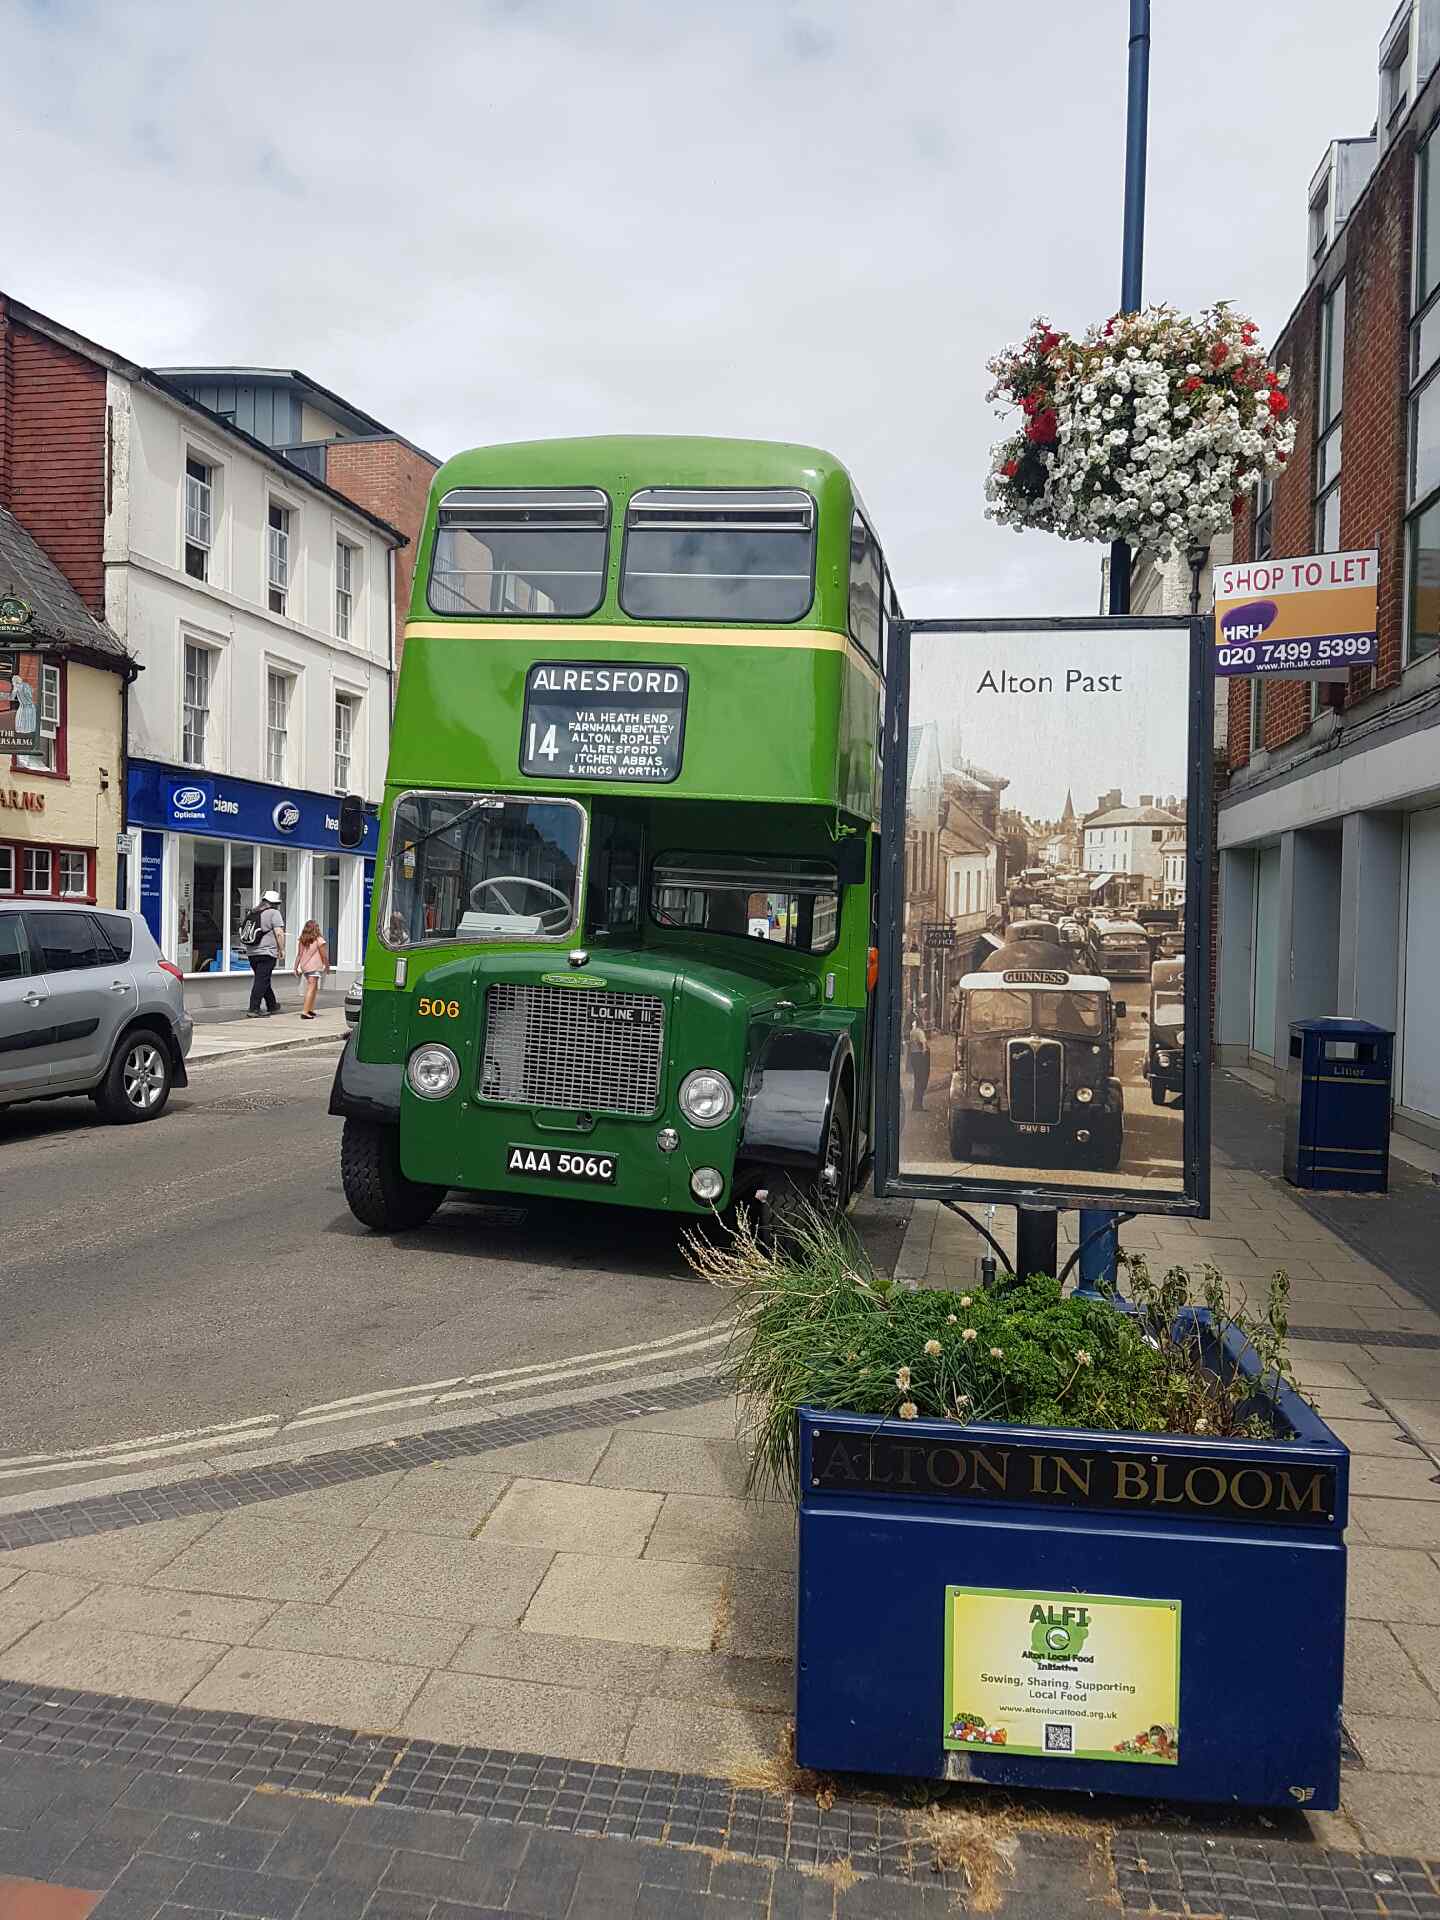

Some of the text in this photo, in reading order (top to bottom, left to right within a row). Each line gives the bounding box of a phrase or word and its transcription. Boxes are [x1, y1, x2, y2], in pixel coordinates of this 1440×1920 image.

[1223, 557, 1371, 594] SHOP TO LET
[1223, 623, 1263, 642] HRH
[1218, 636, 1371, 666] 020 7499 5399
[1256, 657, 1331, 672] www.hrh.uk.com
[533, 669, 679, 693] ALRESFORD
[976, 669, 1122, 694] Alton Past
[576, 711, 668, 724] VIA HEATH END
[528, 723, 559, 762] 14
[571, 733, 670, 746] ALTON. ROPLEY
[580, 744, 658, 755] ALRESFORD
[575, 753, 663, 766] ITCHEN ABBAS
[568, 764, 669, 777] & KINGS WORTHY
[213, 794, 239, 815] cians
[174, 811, 206, 819] Opticians
[1004, 971, 1066, 985] GUINNESS
[418, 998, 460, 1018] 506
[590, 1006, 635, 1021] LOLINE
[509, 1149, 613, 1178] AAA 506C
[823, 1439, 1328, 1513] ALTON IN BLOOM
[1029, 1604, 1089, 1627] ALFI
[1022, 1651, 1095, 1663] Alton Local Food
[1037, 1662, 1078, 1672] Initiative
[980, 1673, 1136, 1694] Sowing, Sharing, Supporting
[1029, 1689, 1087, 1702] Local Food
